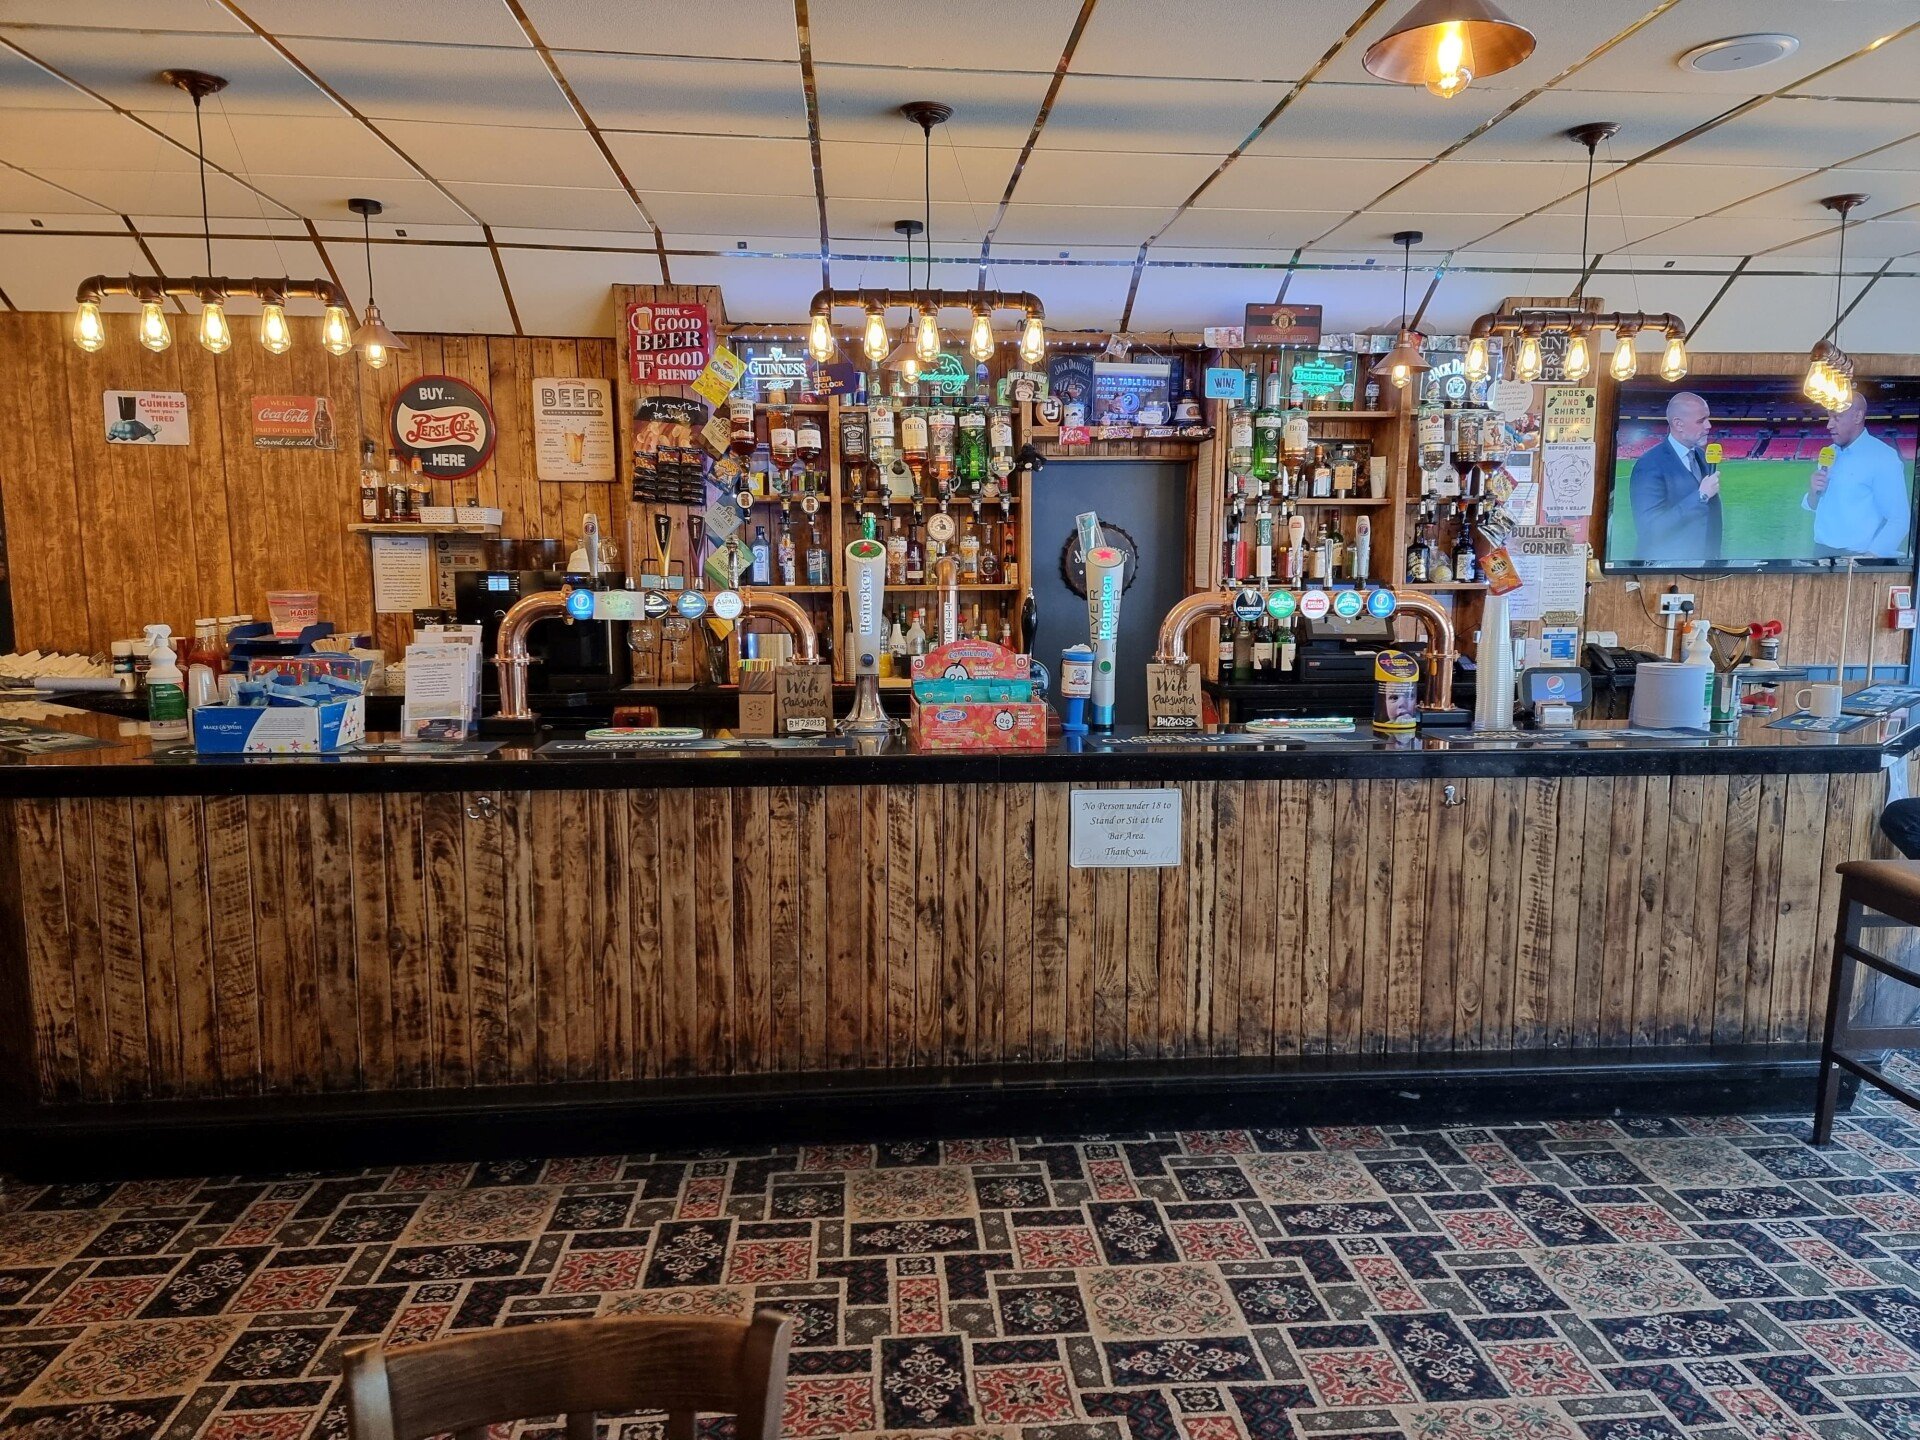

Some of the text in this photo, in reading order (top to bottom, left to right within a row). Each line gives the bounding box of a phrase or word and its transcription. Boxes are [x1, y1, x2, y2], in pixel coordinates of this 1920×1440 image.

[655, 307, 681, 316] DRINK
[654, 317, 702, 331] GOOD
[636, 330, 702, 352] BEER
[656, 352, 704, 366] GOOD
[749, 362, 806, 375] GUINNESS
[1428, 363, 1451, 381] JACK
[1119, 378, 1140, 386] TABLE
[1296, 370, 1341, 381] Heineken
[1214, 378, 1236, 389] WINE
[419, 388, 455, 400] BUY...
[542, 388, 603, 408] BEER
[139, 399, 185, 408] GUINNESS
[642, 399, 701, 411] dry roasted
[258, 407, 310, 423] Coca-Cola
[653, 411, 691, 421] peanuts
[255, 437, 314, 446] Served ice cold
[715, 506, 735, 527] PIPERS
[1511, 527, 1566, 539] BULLSHIT
[1522, 542, 1568, 555] CORNER
[860, 568, 872, 634] Heineken
[1100, 575, 1112, 640] Heineken
[1090, 590, 1099, 652] SILVER
[1112, 590, 1121, 652] SILVER
[960, 650, 993, 658] MILLION
[795, 669, 811, 677] THE
[786, 678, 822, 697] Wifi
[1156, 676, 1191, 696] Wifi
[781, 696, 828, 713] Password
[1152, 694, 1197, 711] Password
[1083, 802, 1095, 811] No
[1097, 803, 1124, 811] Person
[1127, 801, 1149, 809] under
[1090, 815, 1116, 825] Stand
[1126, 816, 1139, 825] Sit
[1151, 815, 1164, 824] the
[1108, 832, 1145, 840] Bar Area.
[1105, 847, 1131, 856] Thank
